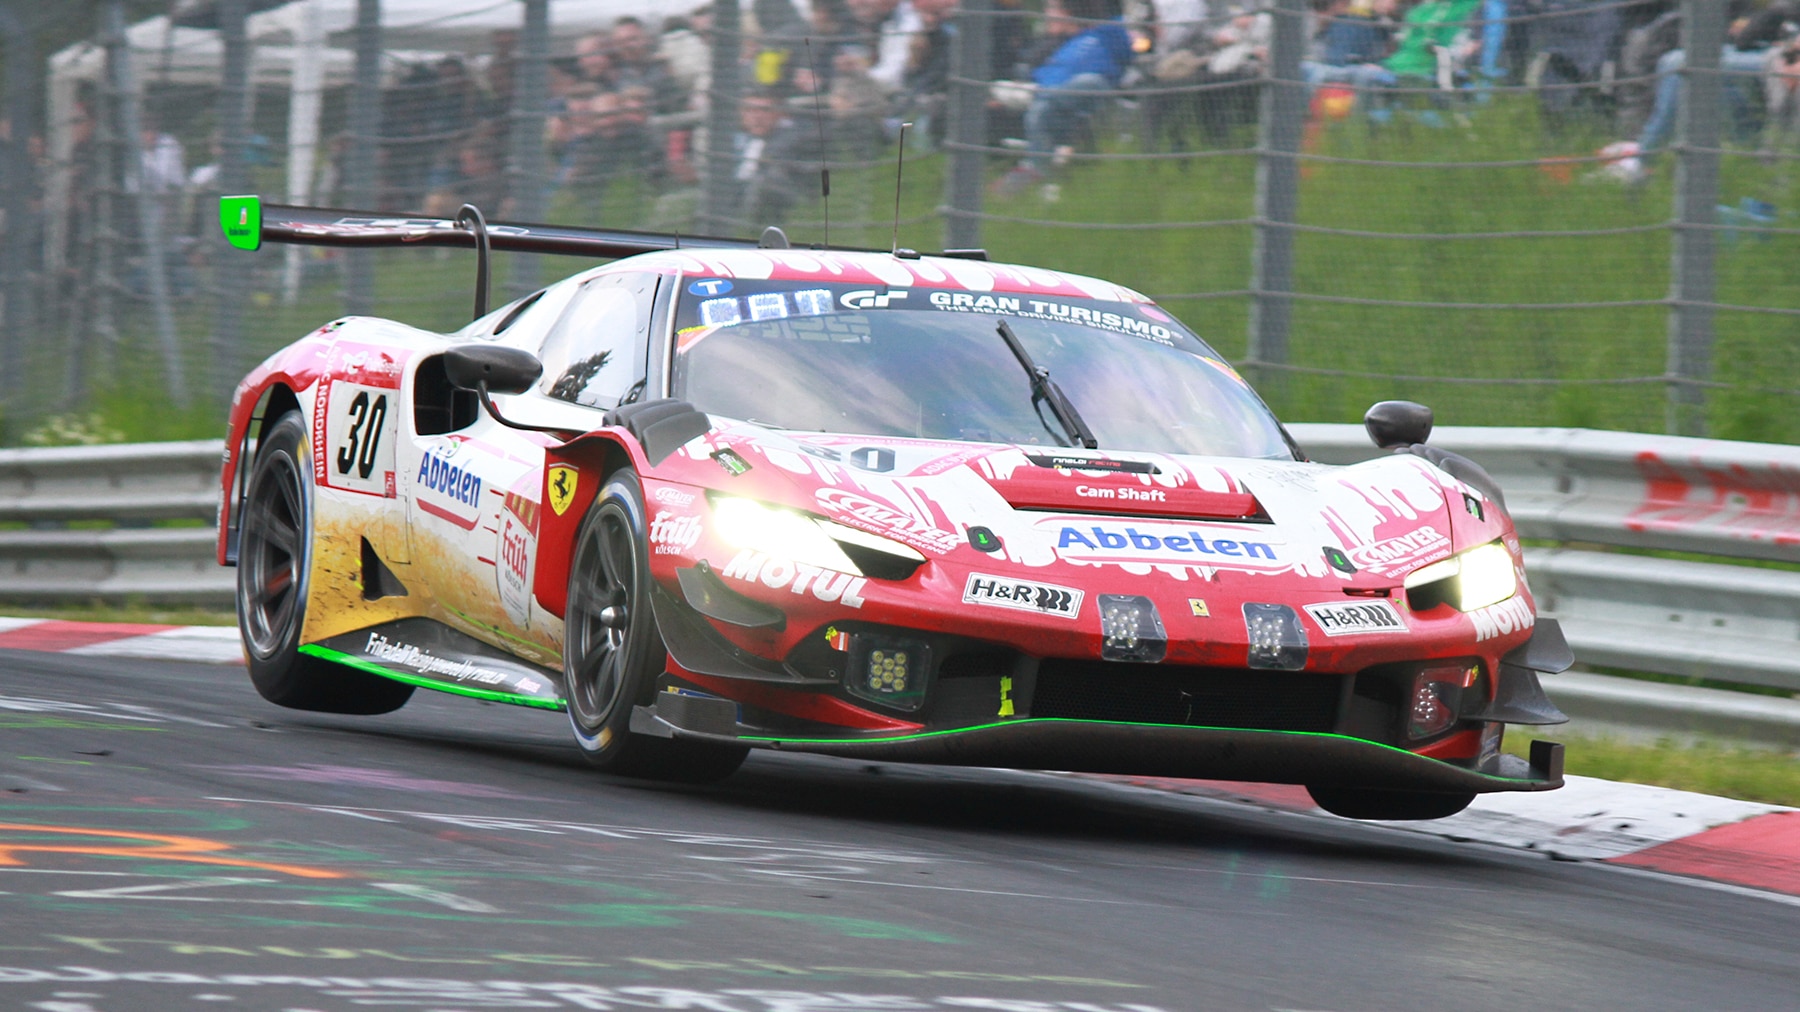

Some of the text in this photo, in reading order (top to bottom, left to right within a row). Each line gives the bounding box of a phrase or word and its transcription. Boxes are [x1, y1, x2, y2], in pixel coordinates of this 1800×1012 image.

[929, 291, 1019, 311] GRAN
[936, 304, 1176, 347] THE REAL DRIVING SIMULATOR
[314, 384, 330, 479] NORDRHEIN
[337, 390, 387, 479] 30
[417, 447, 482, 509] Abbelen
[1075, 485, 1167, 503] Cam Shaft
[838, 515, 948, 555] ELECTRIC FOR RACING
[1057, 526, 1278, 561] Abbelen
[721, 549, 868, 609] MOTUL
[1385, 561, 1413, 579] ELECTRIC
